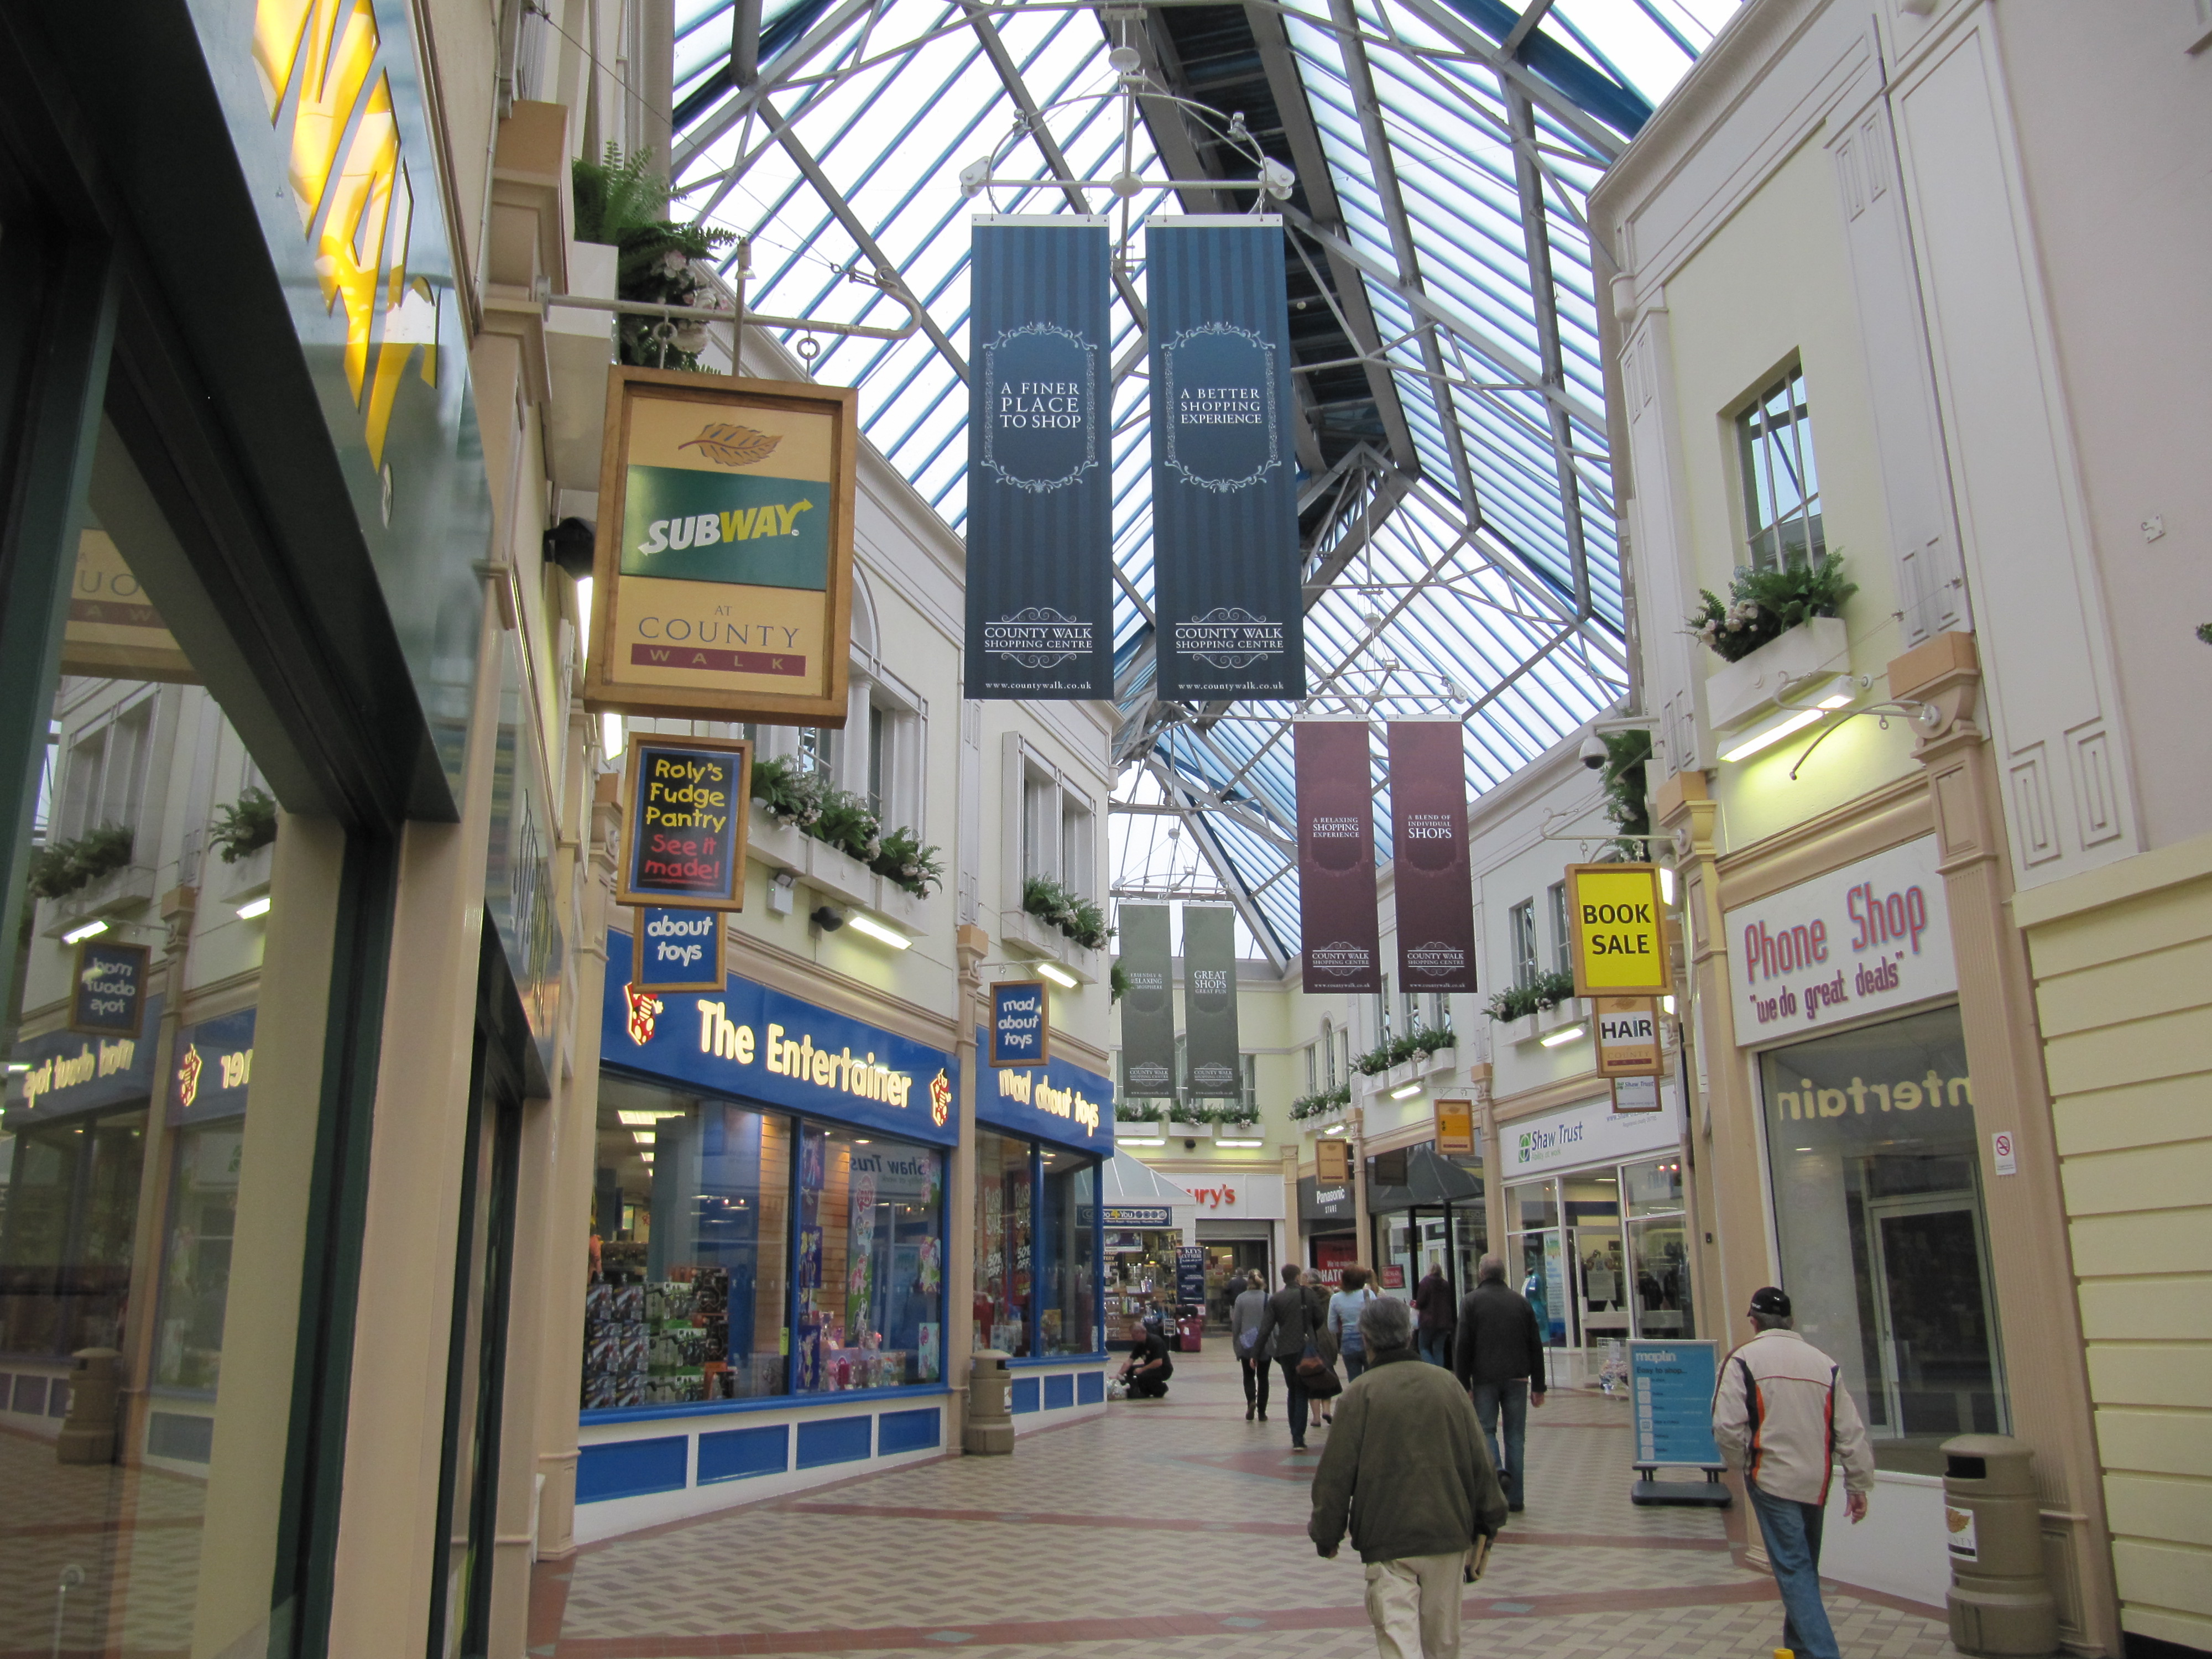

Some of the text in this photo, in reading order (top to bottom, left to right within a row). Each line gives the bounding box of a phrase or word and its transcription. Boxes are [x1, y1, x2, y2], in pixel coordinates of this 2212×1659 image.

[1001, 382, 1080, 395] A FINER
[1181, 388, 1260, 399] A BETTER
[1001, 397, 1079, 413] PLACE
[1181, 401, 1261, 412] SHOPPING
[1000, 414, 1081, 429] TO SHOP
[1181, 413, 1262, 424] EXPERIENCE
[638, 498, 813, 556] SUBWAY
[714, 605, 732, 616] AT
[639, 617, 800, 649] COUNTY
[984, 627, 1092, 639] COUNTY WALK
[1175, 628, 1284, 639] COUNTY WALK
[984, 640, 1093, 648] SHOPPING CENTRE
[1176, 640, 1284, 649] SHOPPING CENTRE
[650, 649, 784, 670] WALK
[985, 681, 1092, 691] www.countywalk.co.uk
[1178, 681, 1284, 691] www.countywalk.co.uk
[655, 759, 723, 784] Roly's
[650, 782, 726, 809] Fudge
[645, 806, 727, 833] Pantry
[1313, 823, 1359, 832] SHOPPING
[1408, 827, 1452, 839] SHOPS
[650, 834, 717, 857] See it
[644, 857, 721, 880] made!
[1583, 903, 1651, 924] BOOK
[648, 915, 713, 937] about
[1744, 881, 1928, 985] Phone Shop
[1592, 933, 1650, 954] SALE
[657, 941, 702, 967] toys
[1194, 971, 1227, 979] GREAT
[1194, 980, 1227, 989] SHOPS
[1779, 985, 1797, 1019] do
[1804, 969, 1848, 1020] great
[1855, 951, 1905, 997] deals"
[1003, 997, 1035, 1012] mad
[998, 1015, 1040, 1030] about
[1004, 1032, 1033, 1049] toys
[698, 999, 912, 1108] The Entertainer
[1608, 1051, 1650, 1060] COUNTY
[999, 1068, 1099, 1138] mad about toys
[1532, 1121, 1583, 1151] Shaw Trust
[1186, 1183, 1235, 1208] ry's
[1317, 1186, 1345, 1204] Panasonic
[1111, 1209, 1120, 1219] 4
[1635, 1350, 1677, 1364] maplin
